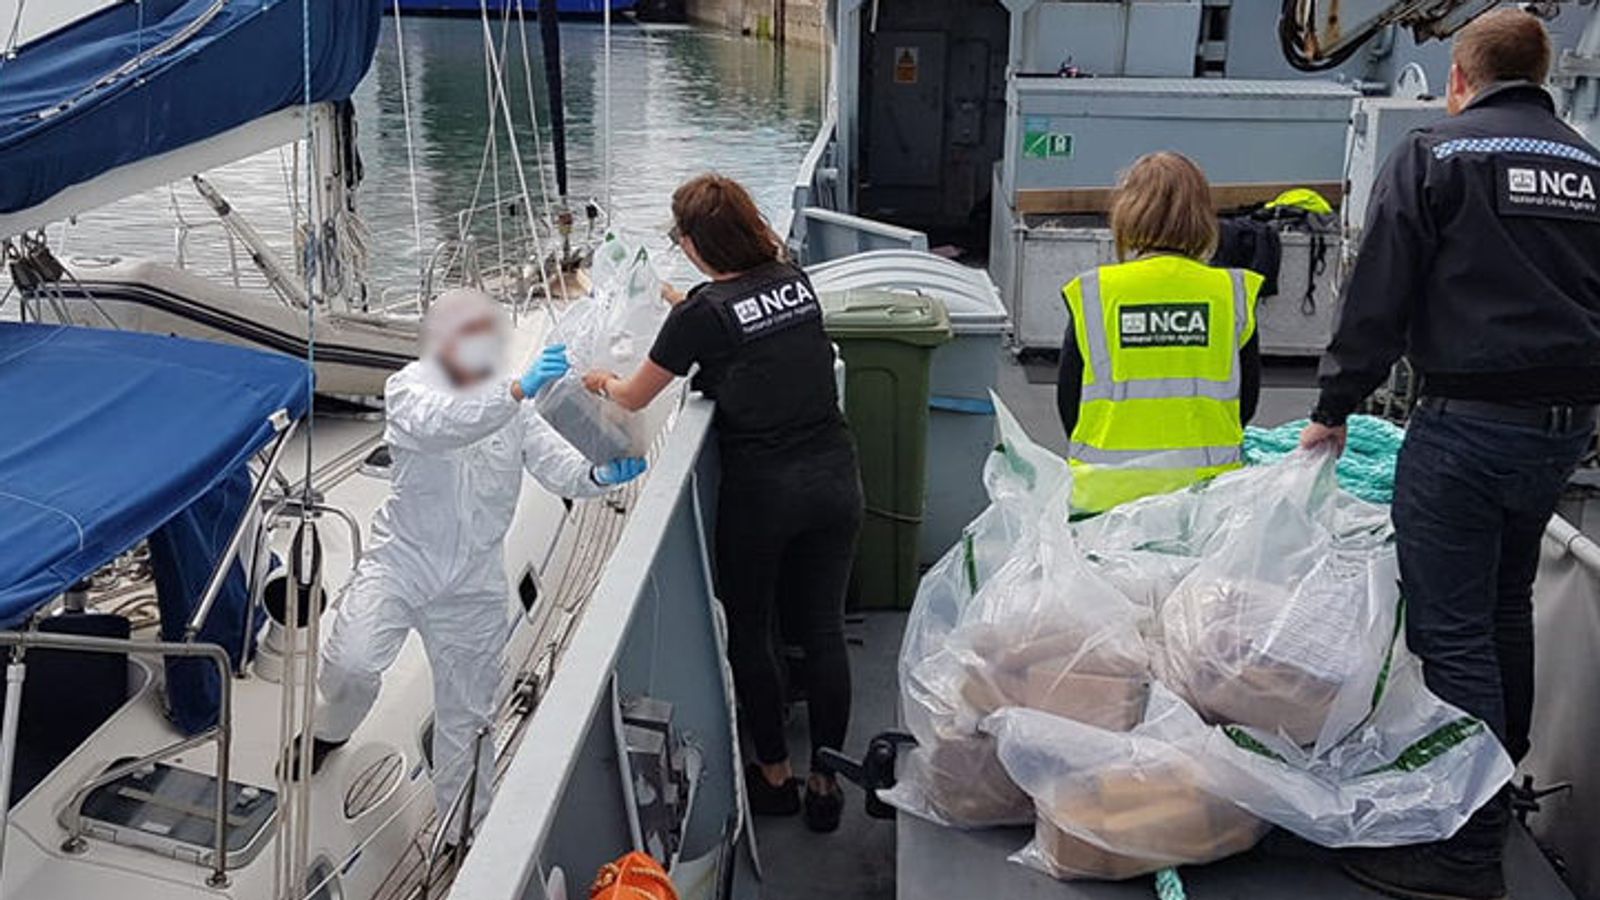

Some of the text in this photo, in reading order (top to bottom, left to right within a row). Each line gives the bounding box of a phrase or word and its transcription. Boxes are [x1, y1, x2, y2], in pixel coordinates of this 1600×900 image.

[1540, 170, 1596, 200] NCA
[759, 281, 814, 315] NCA
[1150, 311, 1206, 332] NCA
